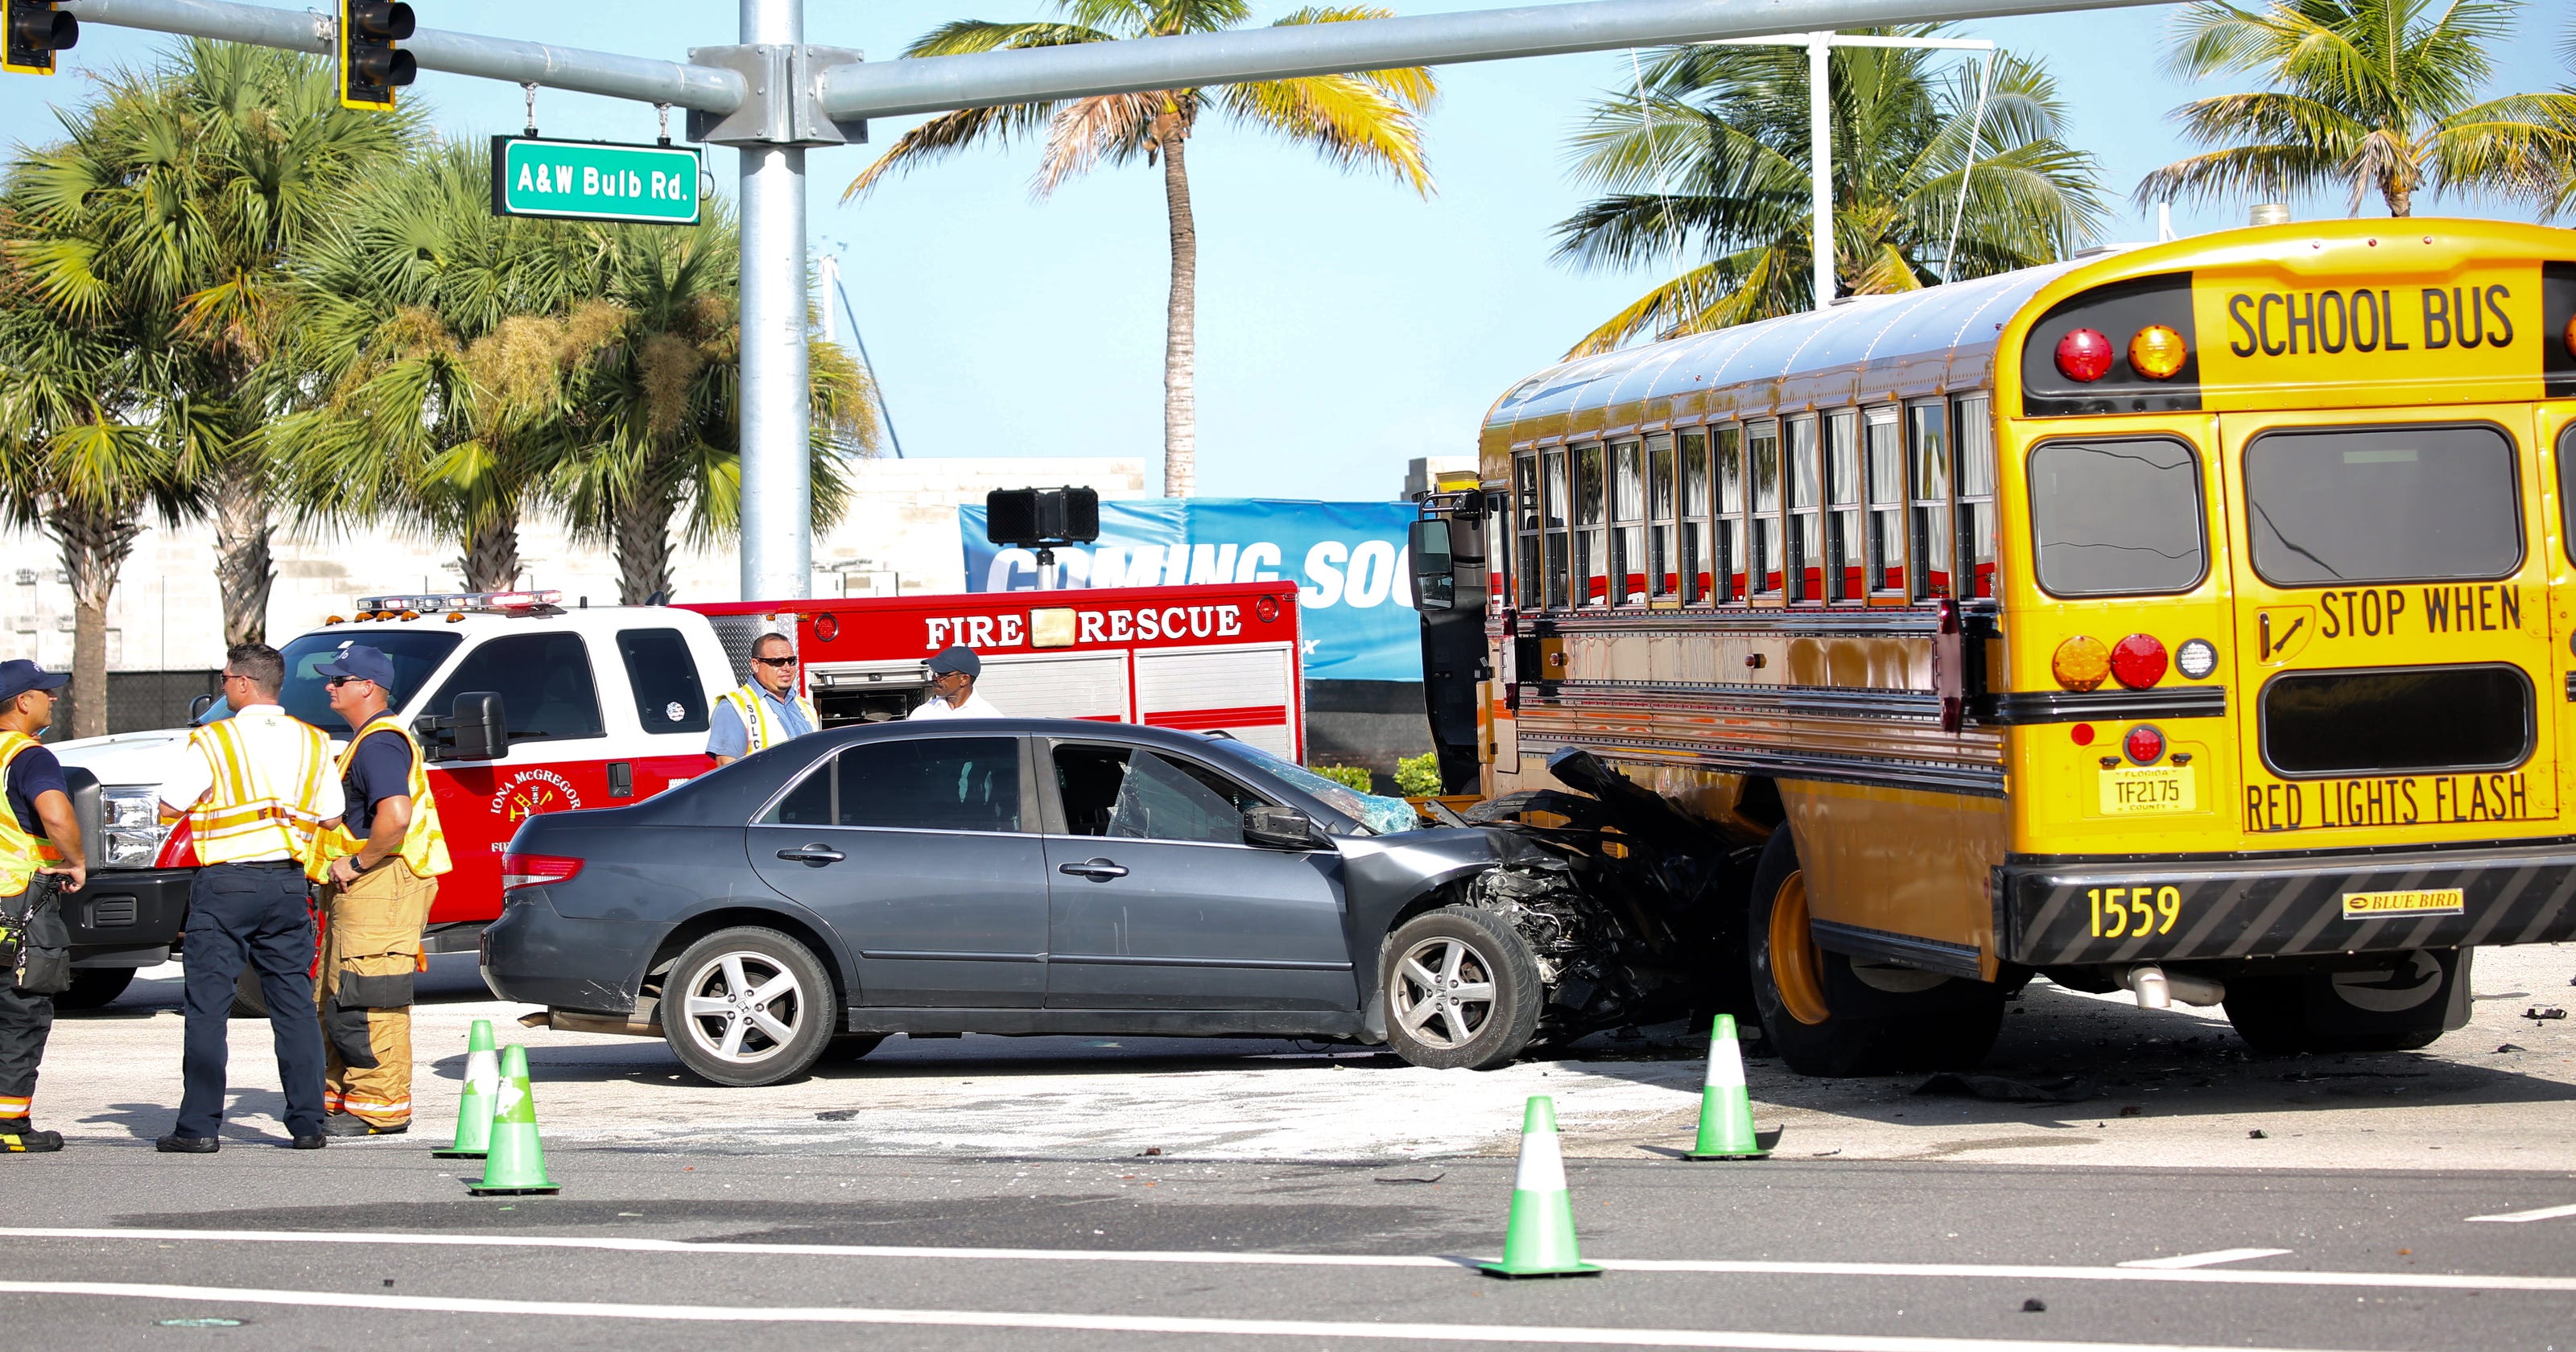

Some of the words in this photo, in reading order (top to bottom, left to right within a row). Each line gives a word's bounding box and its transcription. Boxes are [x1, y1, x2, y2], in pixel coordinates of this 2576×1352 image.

[517, 163, 573, 194] A&W
[583, 167, 642, 198] Bulb
[651, 171, 688, 201] Rd.
[2228, 289, 2409, 357] SCHOOL
[2421, 284, 2513, 349] BUS
[1303, 540, 1413, 610] SO
[926, 614, 1025, 649] FIRE
[1078, 604, 1243, 643] RESCUE
[2321, 589, 2405, 638] STOP
[2423, 584, 2521, 633] WHEN
[490, 781, 515, 814] IONA
[514, 769, 581, 810] McGREGOR
[2116, 780, 2179, 803] TF2175
[2125, 769, 2169, 777] FLORIDA
[2247, 784, 2302, 831] RED
[2321, 778, 2418, 827] LIGHTS
[2436, 773, 2527, 822] FLASH
[2087, 885, 2181, 938] 1559
[2372, 894, 2415, 909] BLUE
[2419, 892, 2458, 908] BIRD
